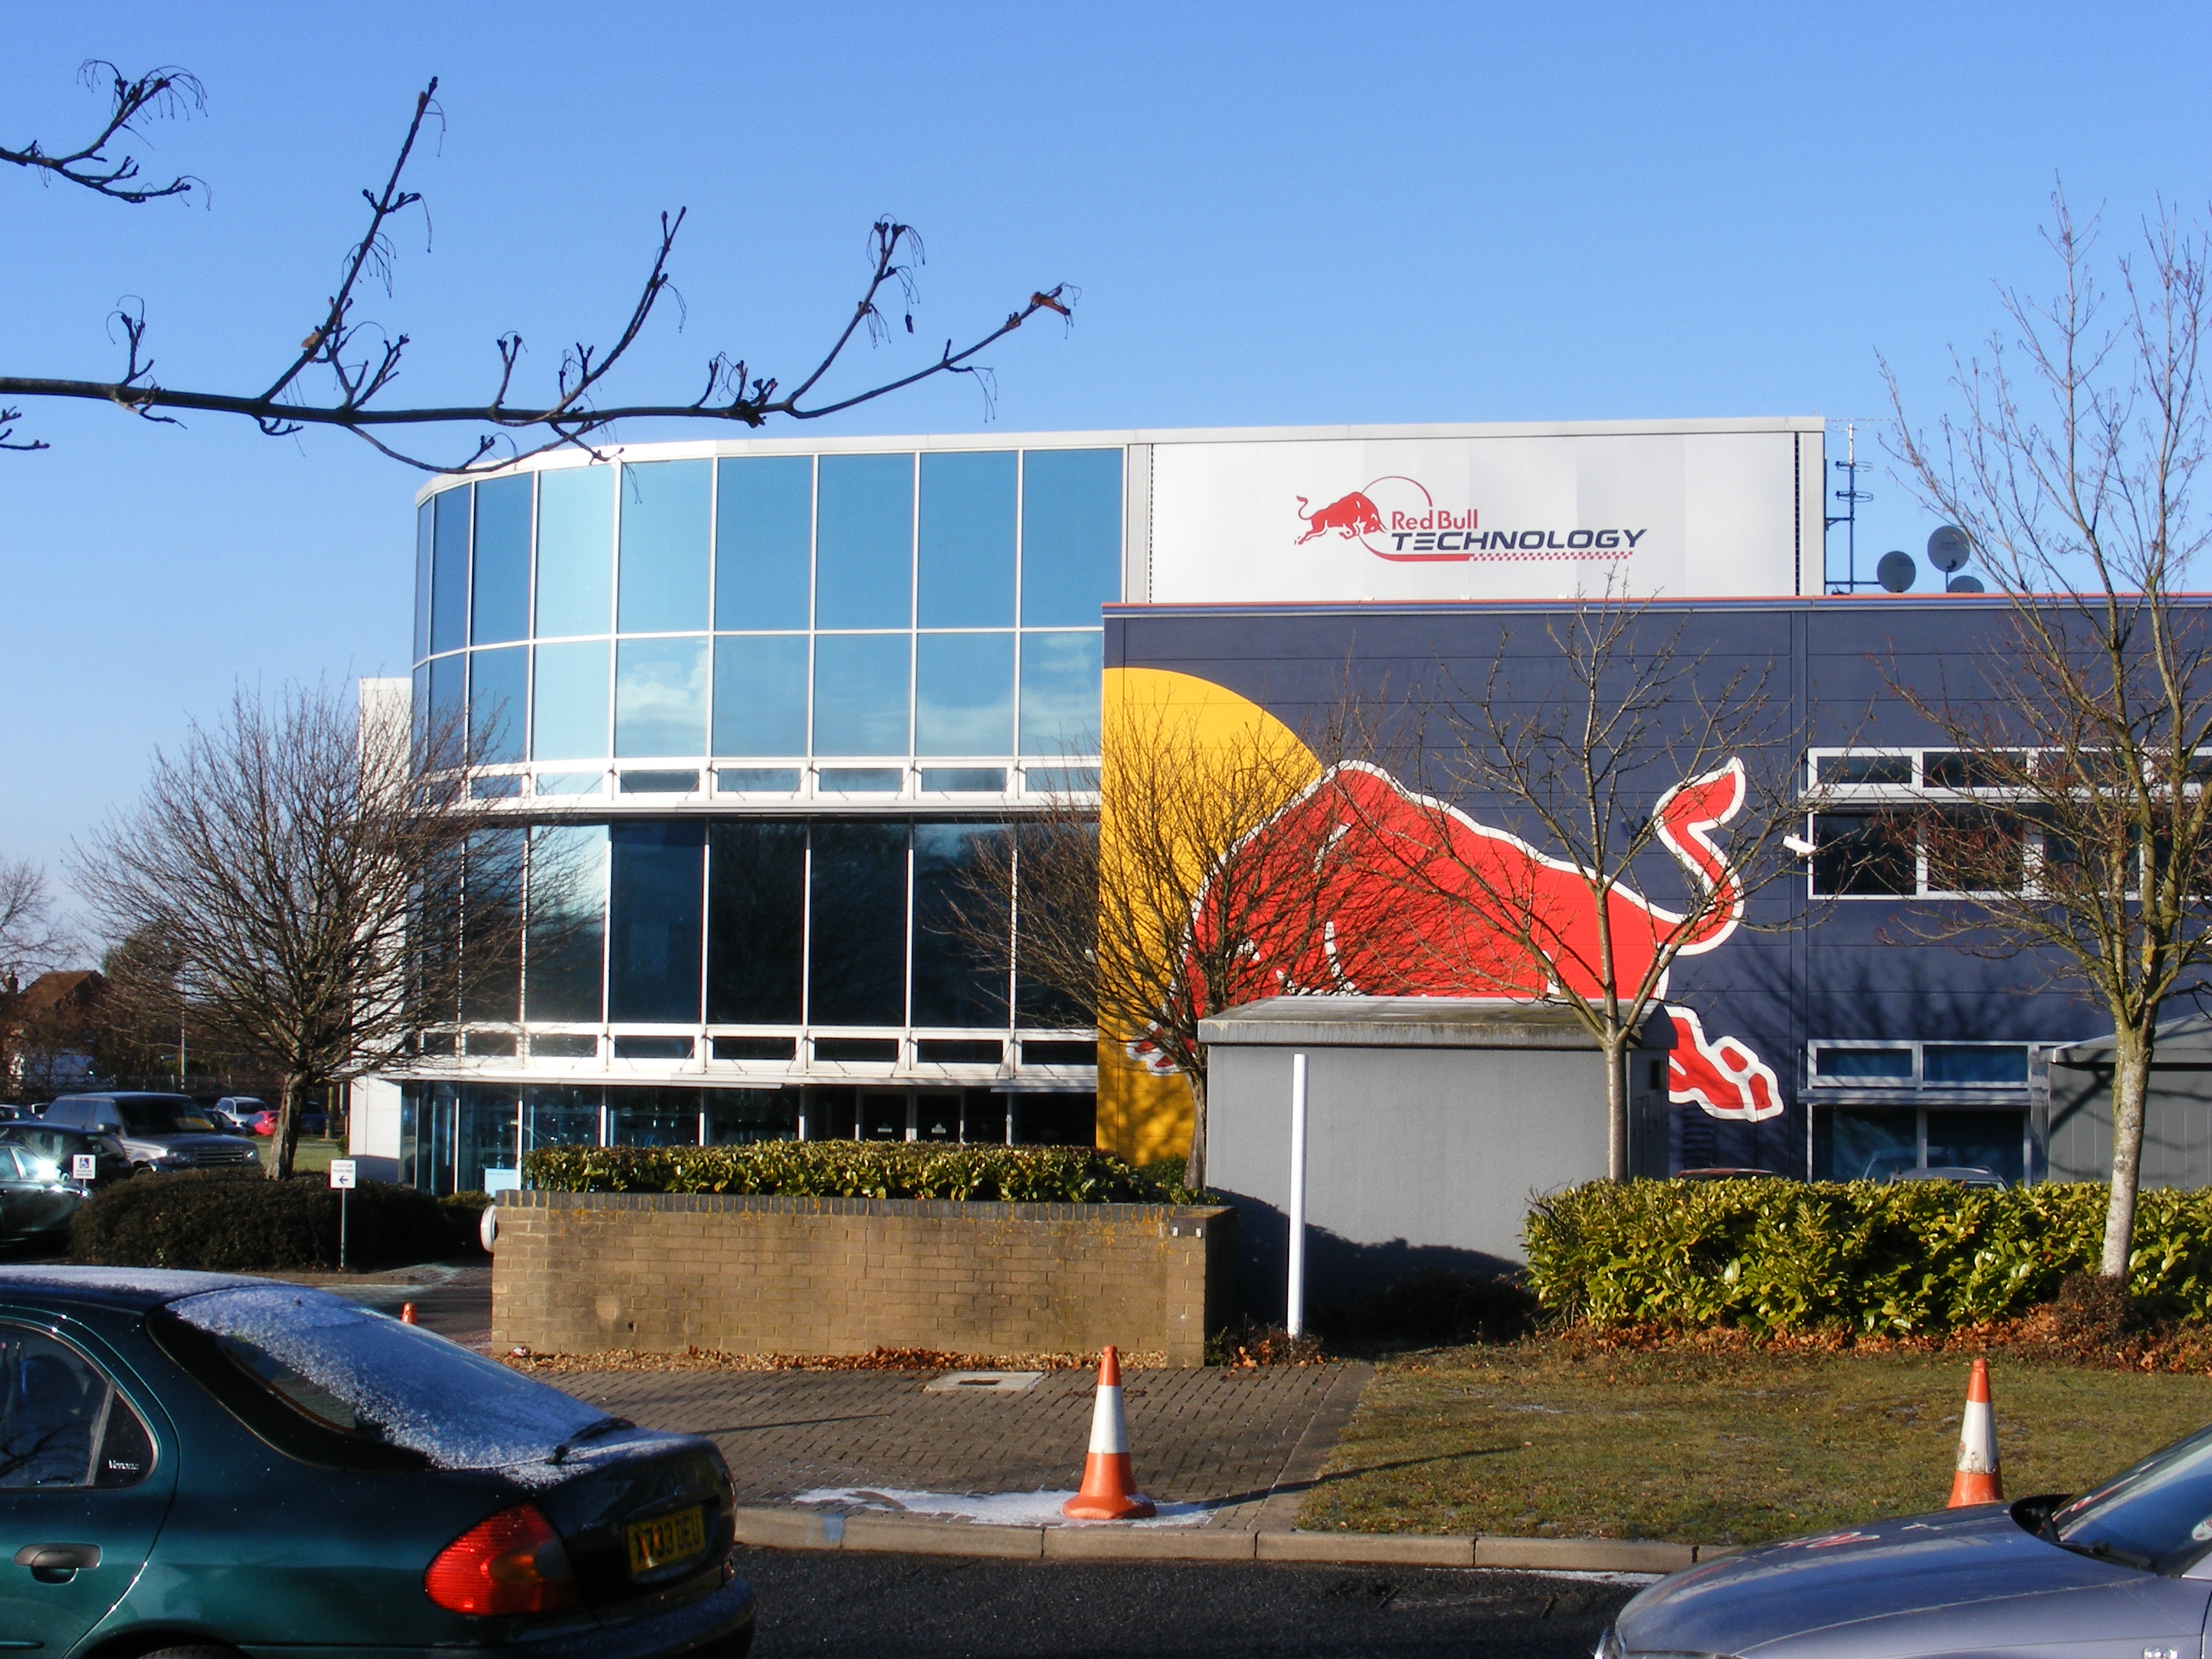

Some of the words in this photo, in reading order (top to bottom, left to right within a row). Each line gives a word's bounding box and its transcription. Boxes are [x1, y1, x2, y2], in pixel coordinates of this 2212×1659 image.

[1392, 509, 1433, 530] Red
[1437, 508, 1478, 530] Bull
[1391, 529, 1647, 551] TECHNOLOGY
